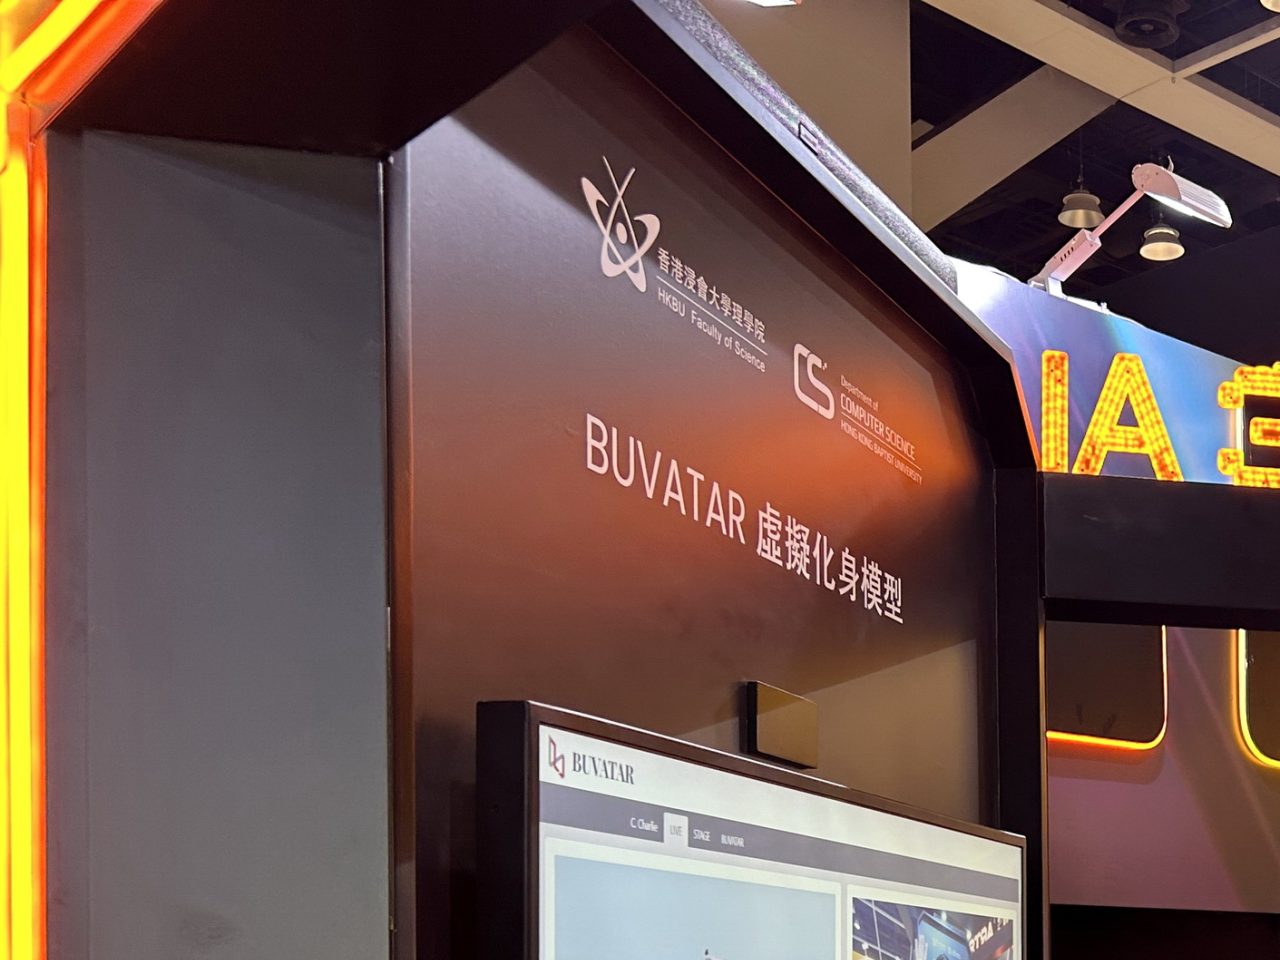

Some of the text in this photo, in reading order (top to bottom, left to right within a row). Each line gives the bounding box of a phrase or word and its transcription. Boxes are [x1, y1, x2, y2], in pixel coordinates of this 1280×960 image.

[657, 246, 766, 344] 香港浸會大學理學院
[657, 286, 766, 373] HKBU Faculty of Science
[840, 393, 916, 461] COMPUTER SCIENCE
[586, 412, 904, 625] BUVATAR 虛擬化身模型
[572, 751, 635, 785] BUVATAR
